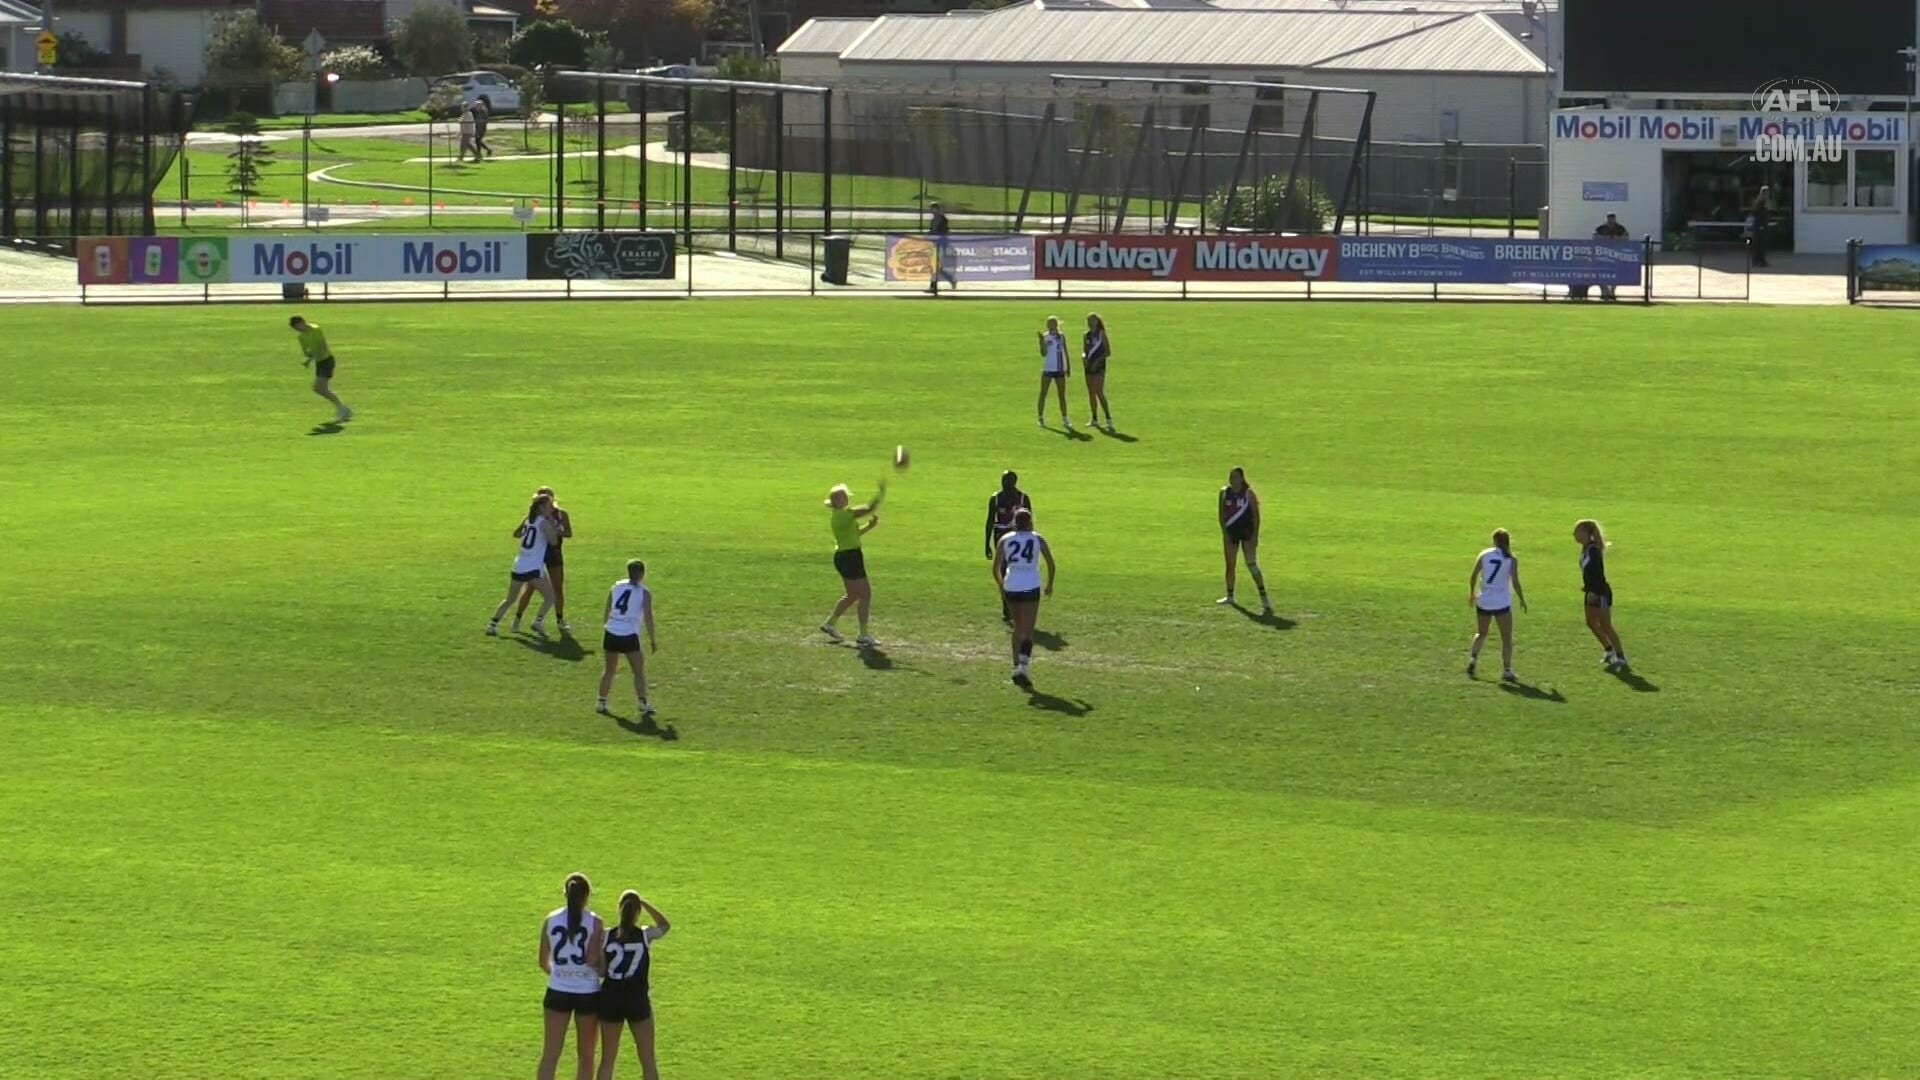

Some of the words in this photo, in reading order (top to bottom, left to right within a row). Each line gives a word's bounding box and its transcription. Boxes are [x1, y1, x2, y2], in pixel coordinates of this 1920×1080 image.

[1556, 115, 1631, 139] Mobil
[1639, 116, 1715, 140] Mobil
[1739, 116, 1816, 141] Mobil
[1824, 117, 1900, 141] Mobil
[254, 243, 352, 275] Mobil
[403, 241, 501, 274] Mobil
[1044, 239, 1178, 277] Midway
[1195, 241, 1329, 277] Midway
[1341, 242, 1406, 258] BREHENY
[1495, 244, 1560, 261] BREHENY
[520, 525, 537, 550] 0
[1007, 539, 1034, 564] 24
[1486, 559, 1502, 584] 7
[615, 589, 632, 615] 4
[551, 925, 588, 965] 23
[606, 942, 645, 980] 27
